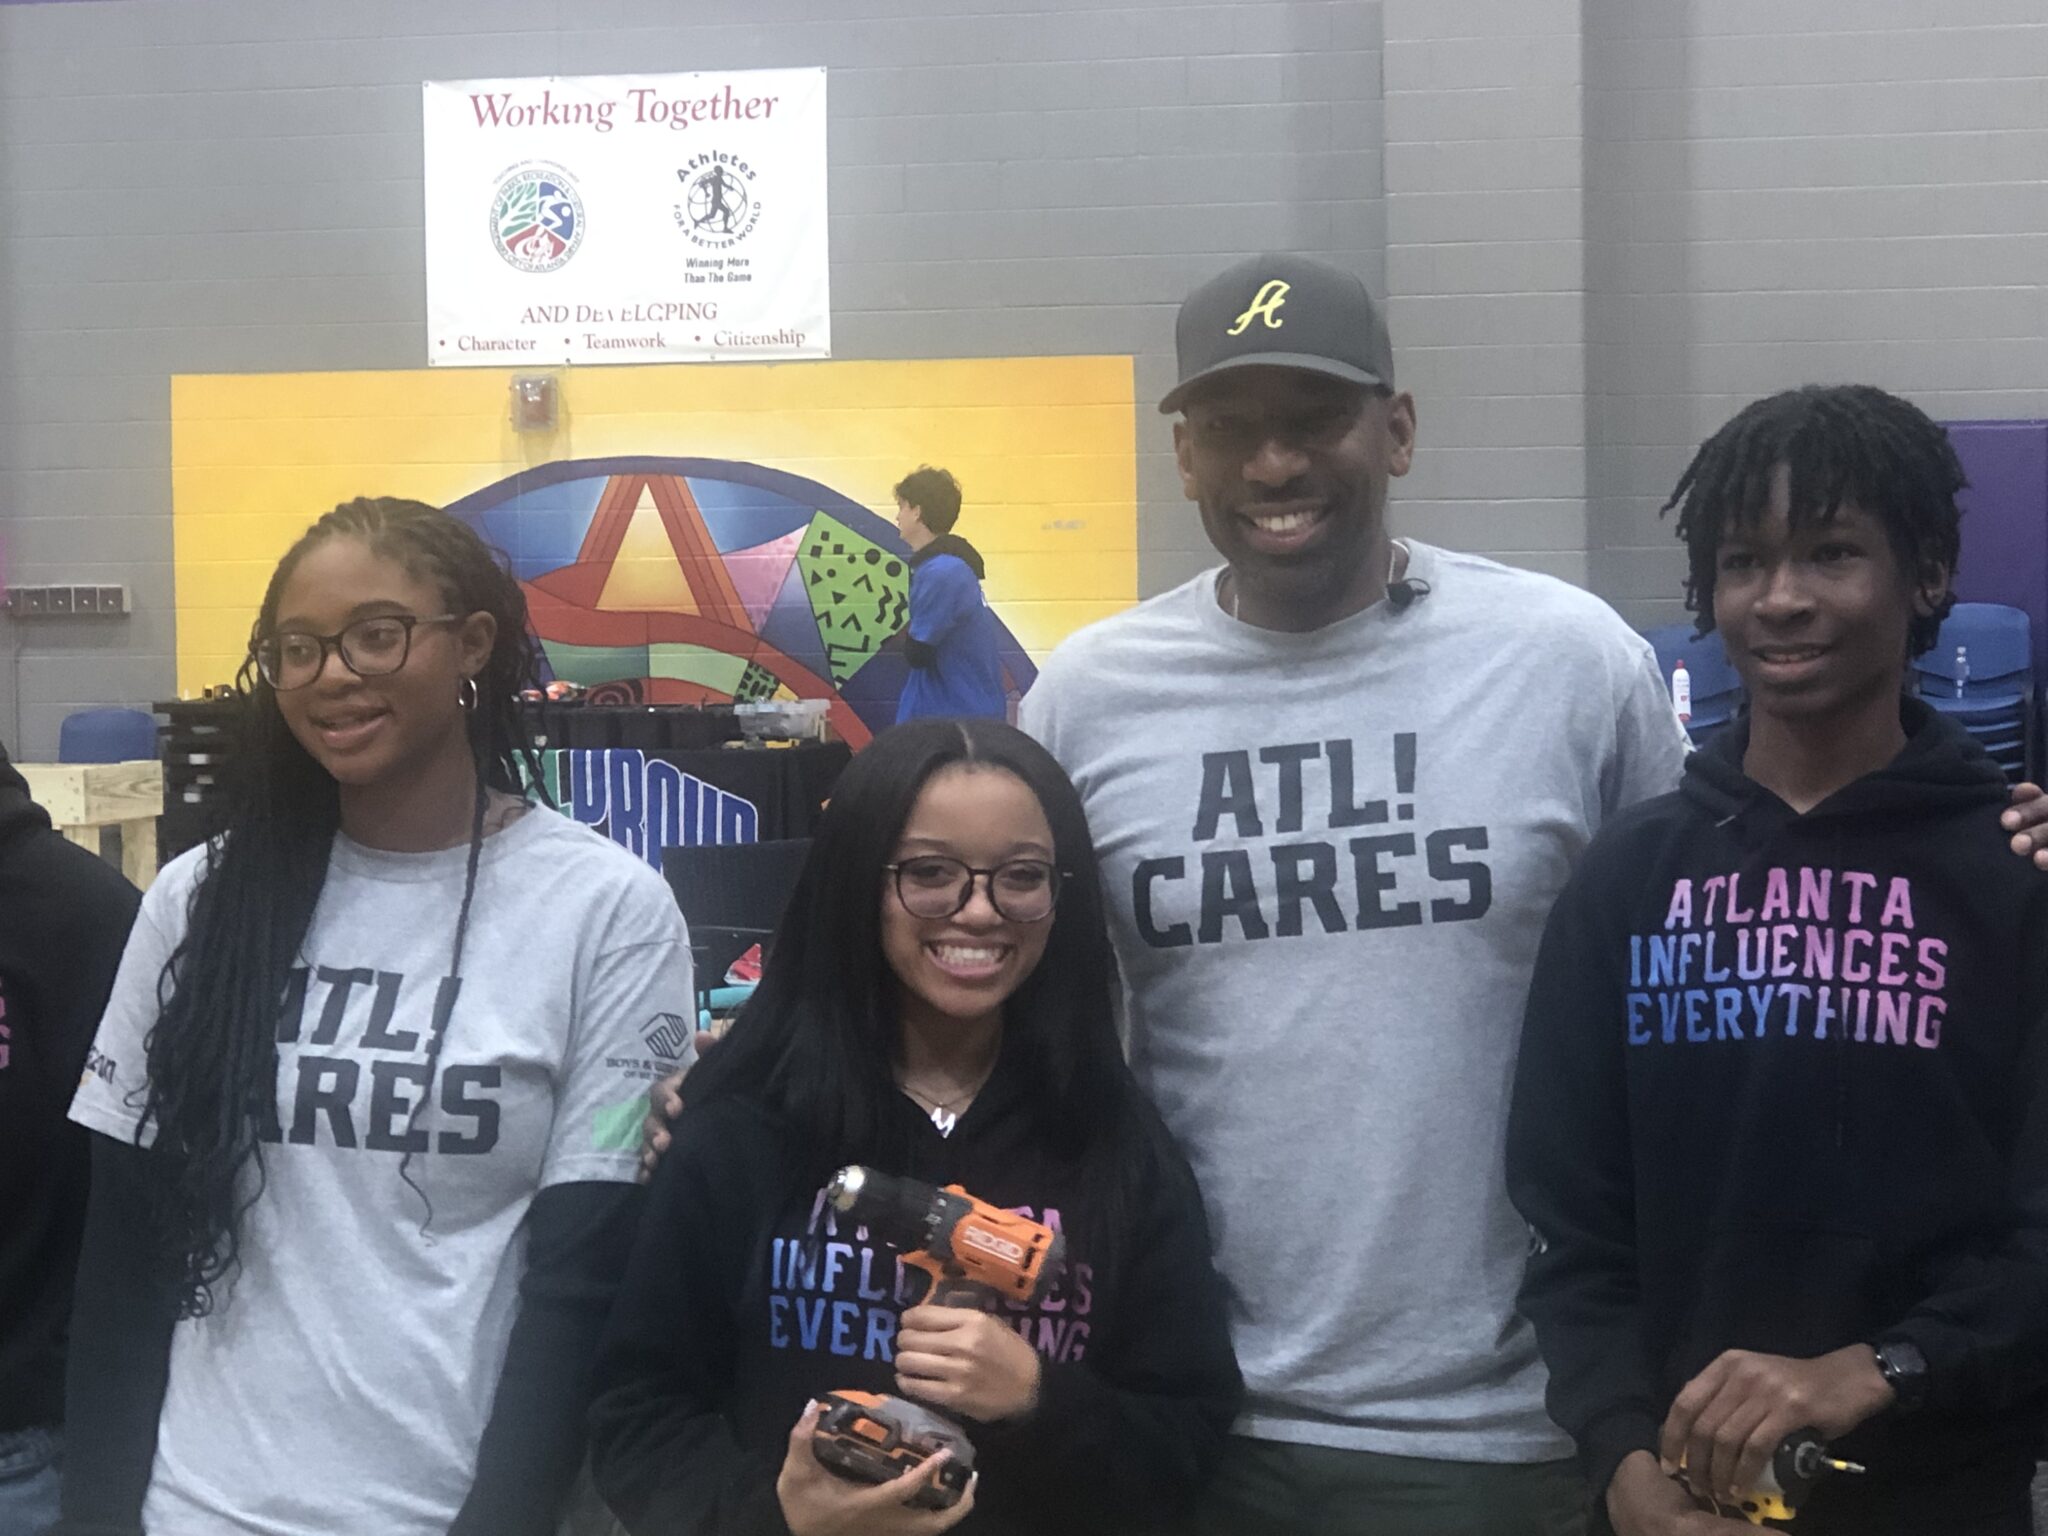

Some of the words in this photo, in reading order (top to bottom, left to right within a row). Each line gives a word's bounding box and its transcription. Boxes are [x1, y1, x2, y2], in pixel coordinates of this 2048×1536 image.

[468, 90, 617, 133] Working
[627, 85, 779, 130] Together
[676, 150, 758, 183] Athletes
[673, 204, 685, 228] FOR
[682, 228, 690, 237] A
[691, 235, 735, 249] BETTER
[736, 201, 762, 241] WORLD
[684, 273, 705, 283] Than
[708, 272, 724, 283] The
[727, 272, 752, 282] Game
[686, 258, 724, 270] Winning
[727, 257, 750, 267] More
[520, 306, 569, 324] AND
[1226, 279, 1291, 336] A
[457, 336, 536, 351] Character
[583, 332, 666, 350] Teamwork
[713, 329, 806, 347] Citizenship
[1192, 732, 1417, 841] ATL!
[1132, 826, 1492, 948] CARES
[1664, 866, 1914, 930] ATLANTA
[1629, 924, 1948, 991] INFLUENCES
[1626, 982, 1948, 1050] EVERYTHING
